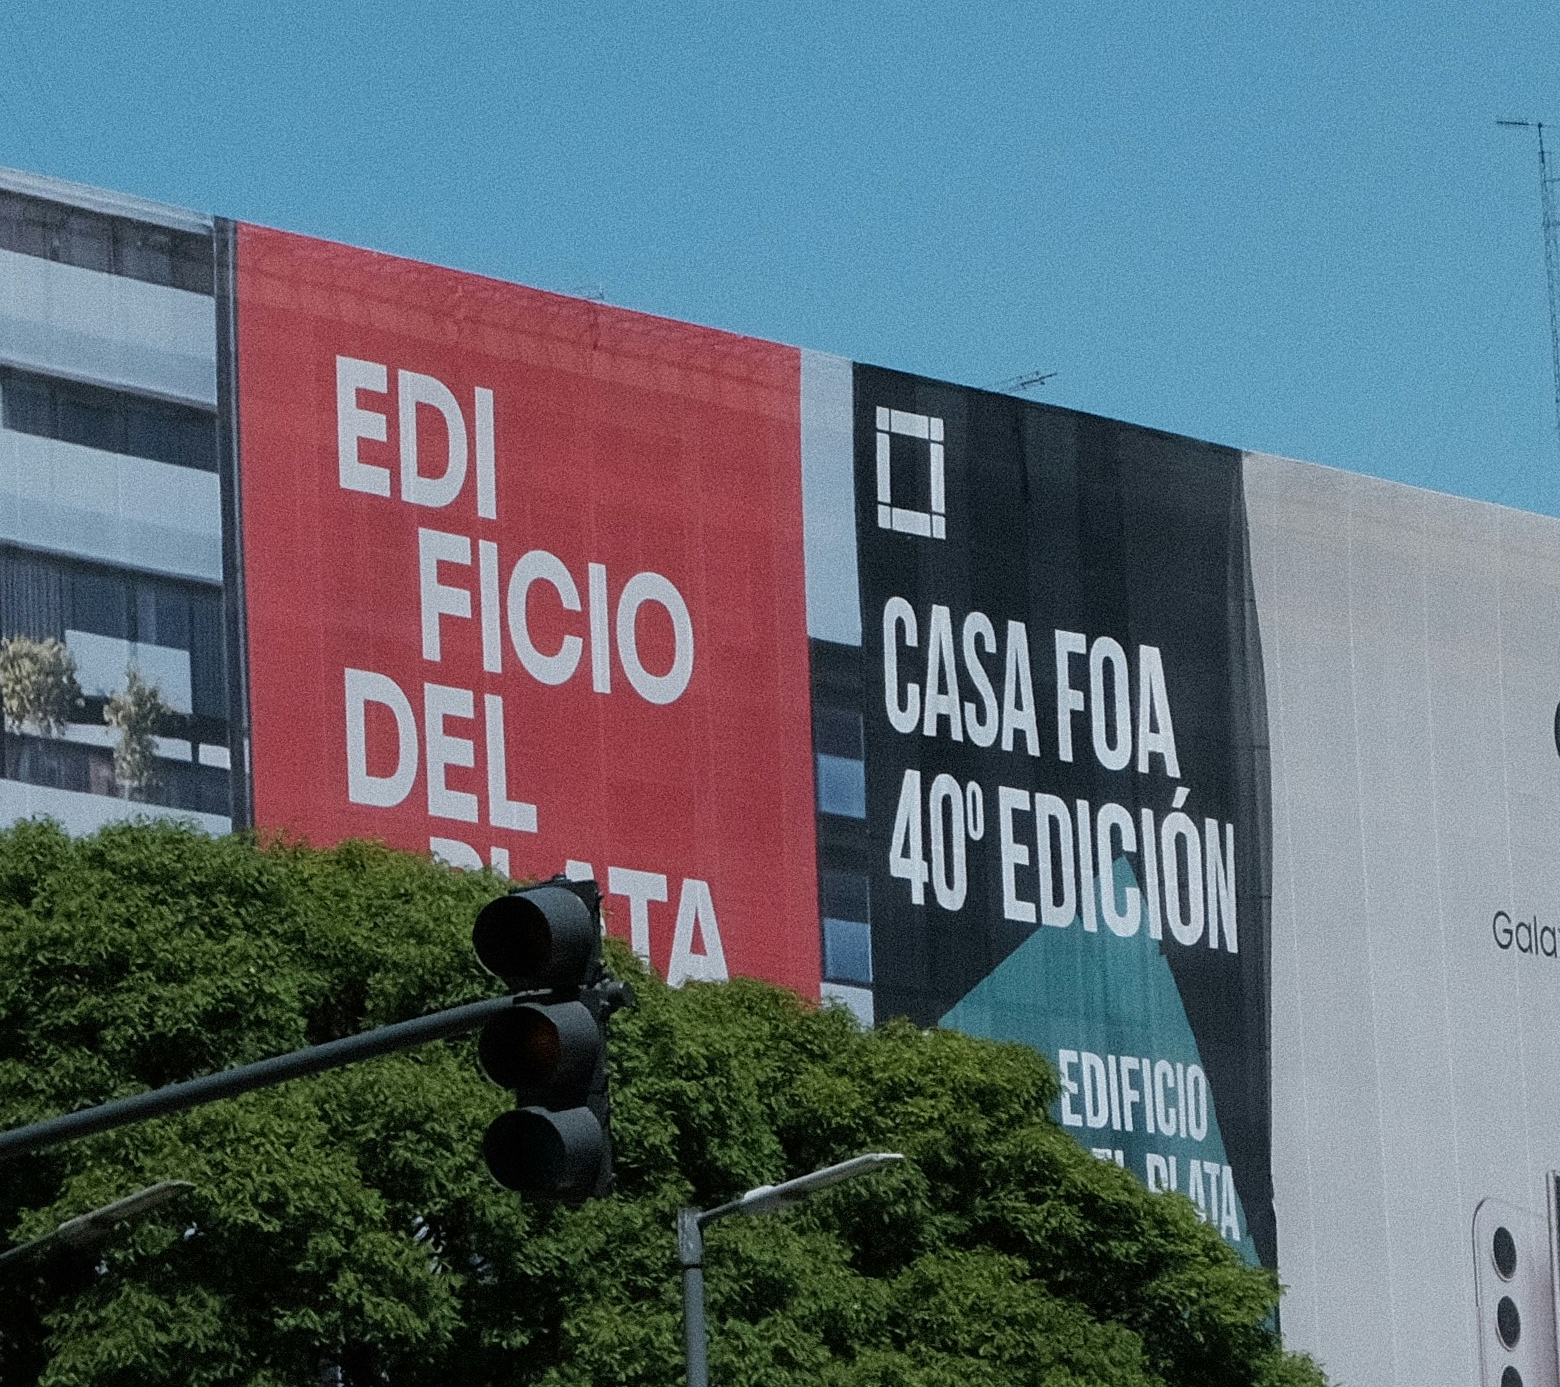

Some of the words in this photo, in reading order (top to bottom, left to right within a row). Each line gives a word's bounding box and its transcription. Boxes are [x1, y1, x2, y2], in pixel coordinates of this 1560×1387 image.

[335, 356, 498, 519] EDI
[420, 527, 694, 705] FICIO
[882, 595, 1040, 759] CASA
[1056, 630, 1181, 780] FOA
[344, 668, 538, 833] DEL
[999, 784, 1240, 955] EDICIÓN
[1059, 1049, 1208, 1141] EDIFICIO
